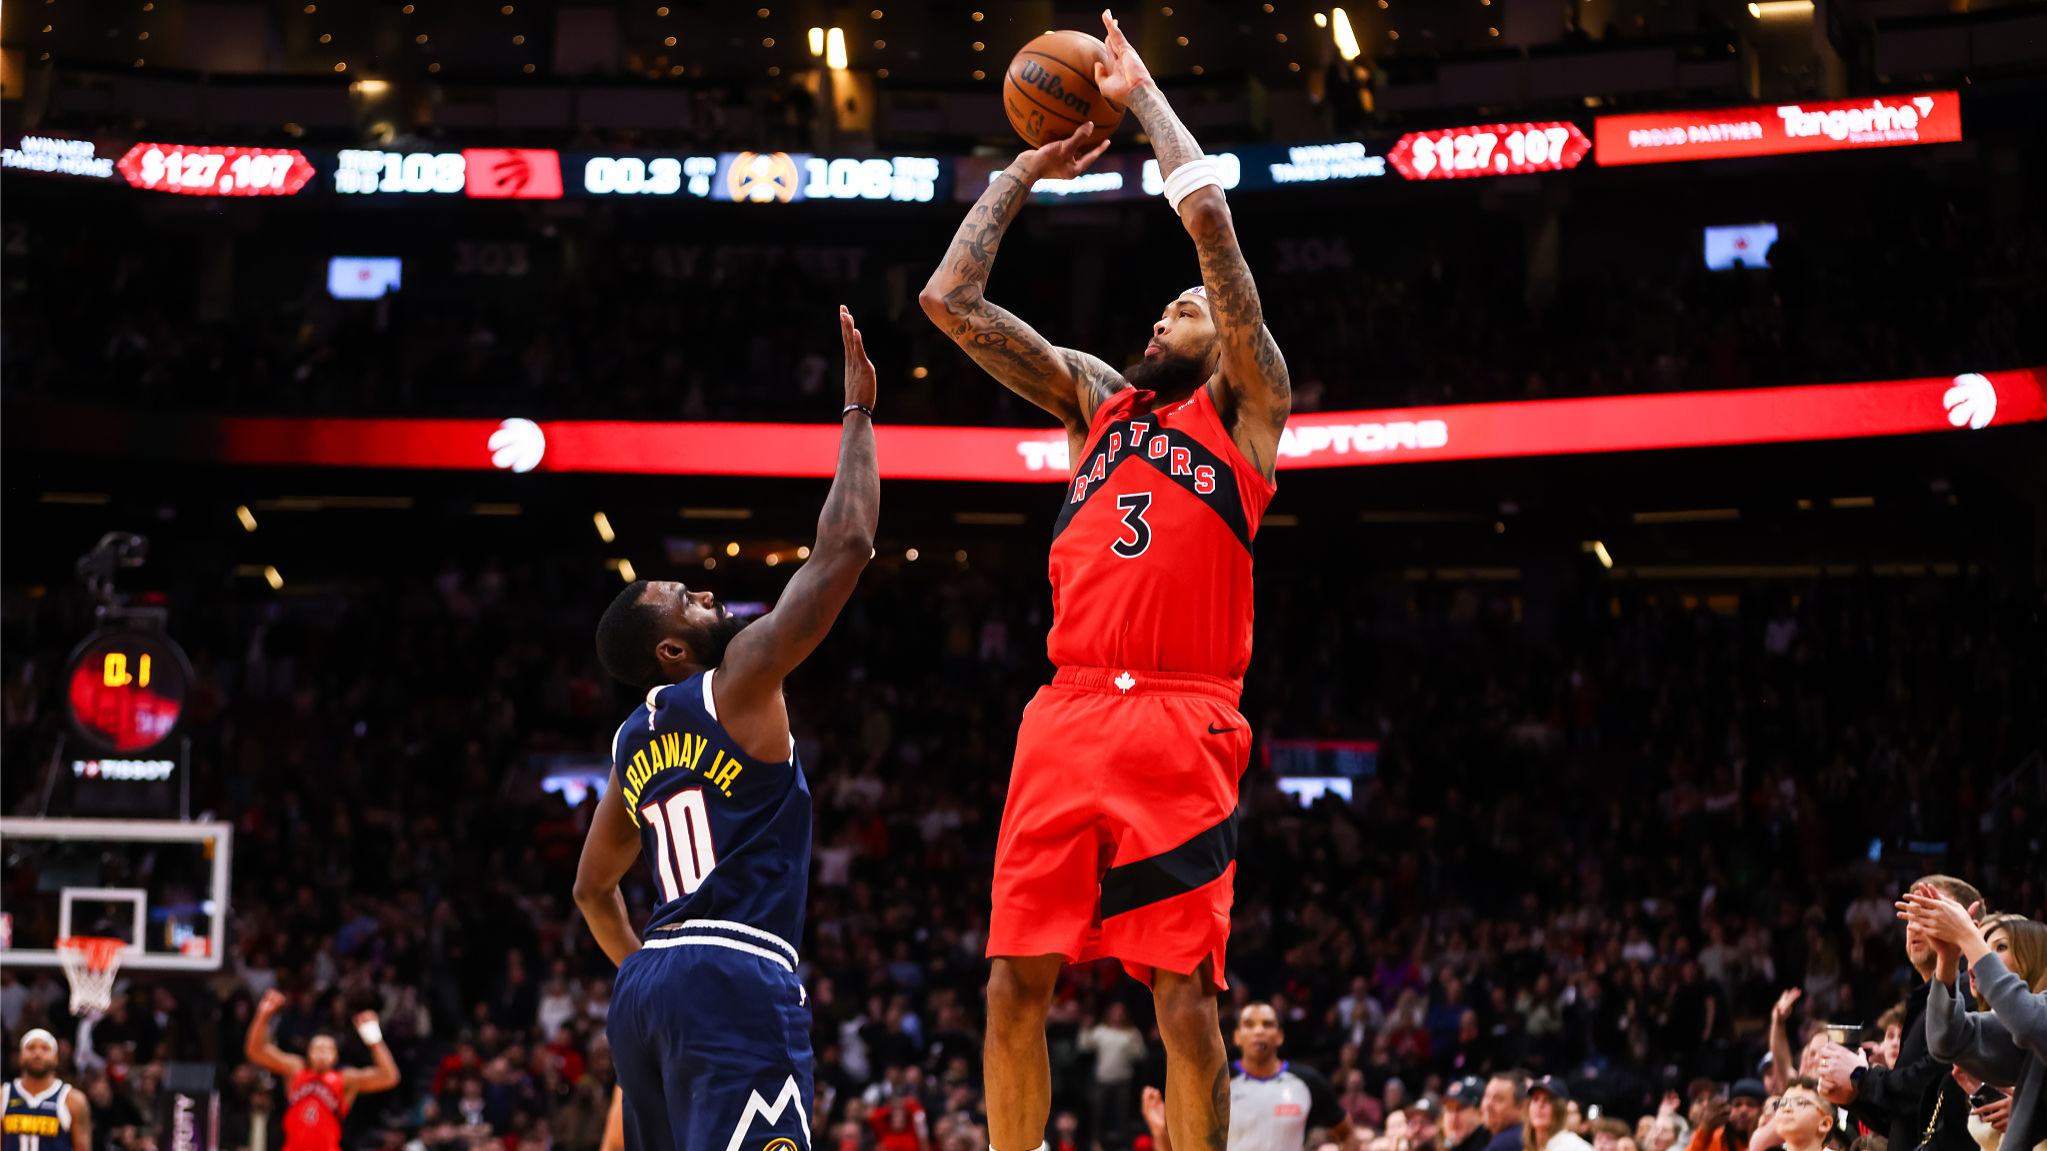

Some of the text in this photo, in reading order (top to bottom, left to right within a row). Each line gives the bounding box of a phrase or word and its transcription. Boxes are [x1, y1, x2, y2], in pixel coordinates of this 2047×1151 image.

[1020, 60, 1092, 117] Wilson
[1628, 121, 1763, 148] PROUD PARTNER
[1777, 99, 1918, 140] Tangerine
[140, 148, 294, 193] $127,107
[1411, 127, 1569, 179] $127,107
[803, 158, 893, 199] 106
[1276, 236, 1354, 274] 304
[1277, 419, 1449, 457] APTORS
[1070, 421, 1216, 504] RAPTORS
[1110, 491, 1152, 559] 3
[103, 653, 151, 688] 0.1
[703, 749, 743, 798] JR.
[639, 786, 718, 904] 10
